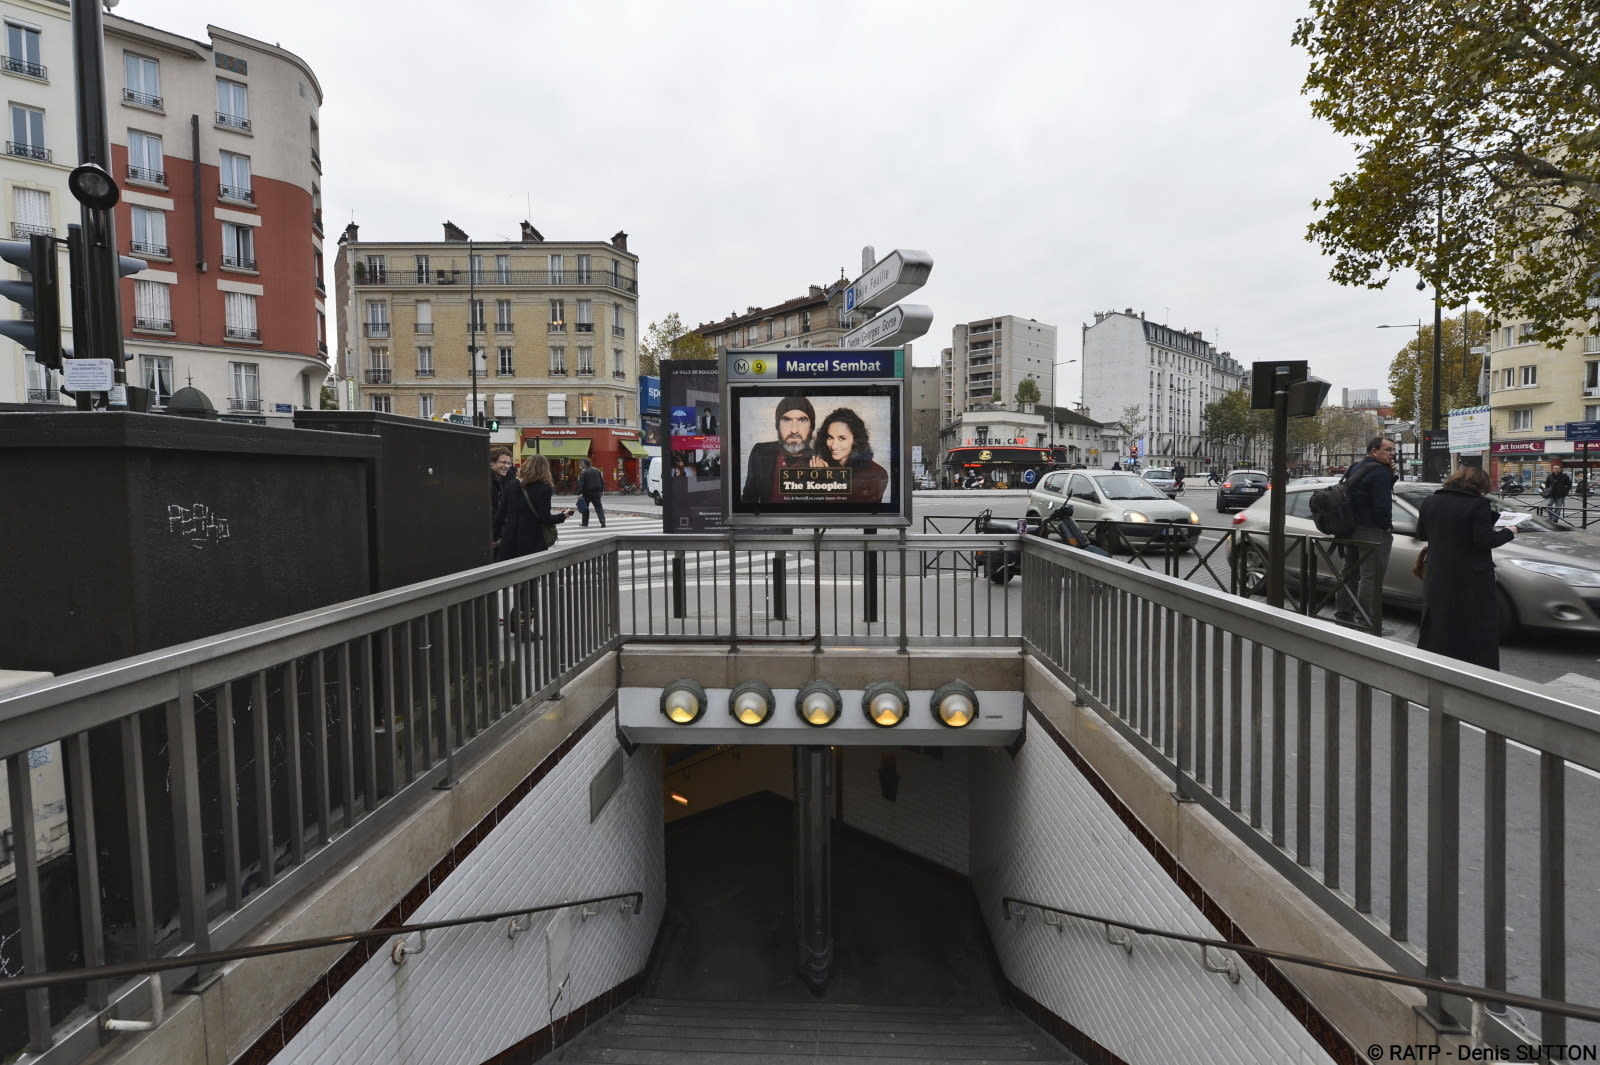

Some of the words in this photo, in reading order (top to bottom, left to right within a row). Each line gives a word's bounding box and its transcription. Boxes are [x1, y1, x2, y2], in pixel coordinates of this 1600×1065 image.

[861, 325, 880, 342] Georges
[882, 316, 897, 331] Gorse
[786, 360, 829, 373] Marcel
[832, 360, 881, 372] Sembat
[1511, 442, 1529, 450] tours
[783, 470, 847, 479] SPORT
[783, 481, 803, 490] The
[806, 481, 847, 491] Kooples
